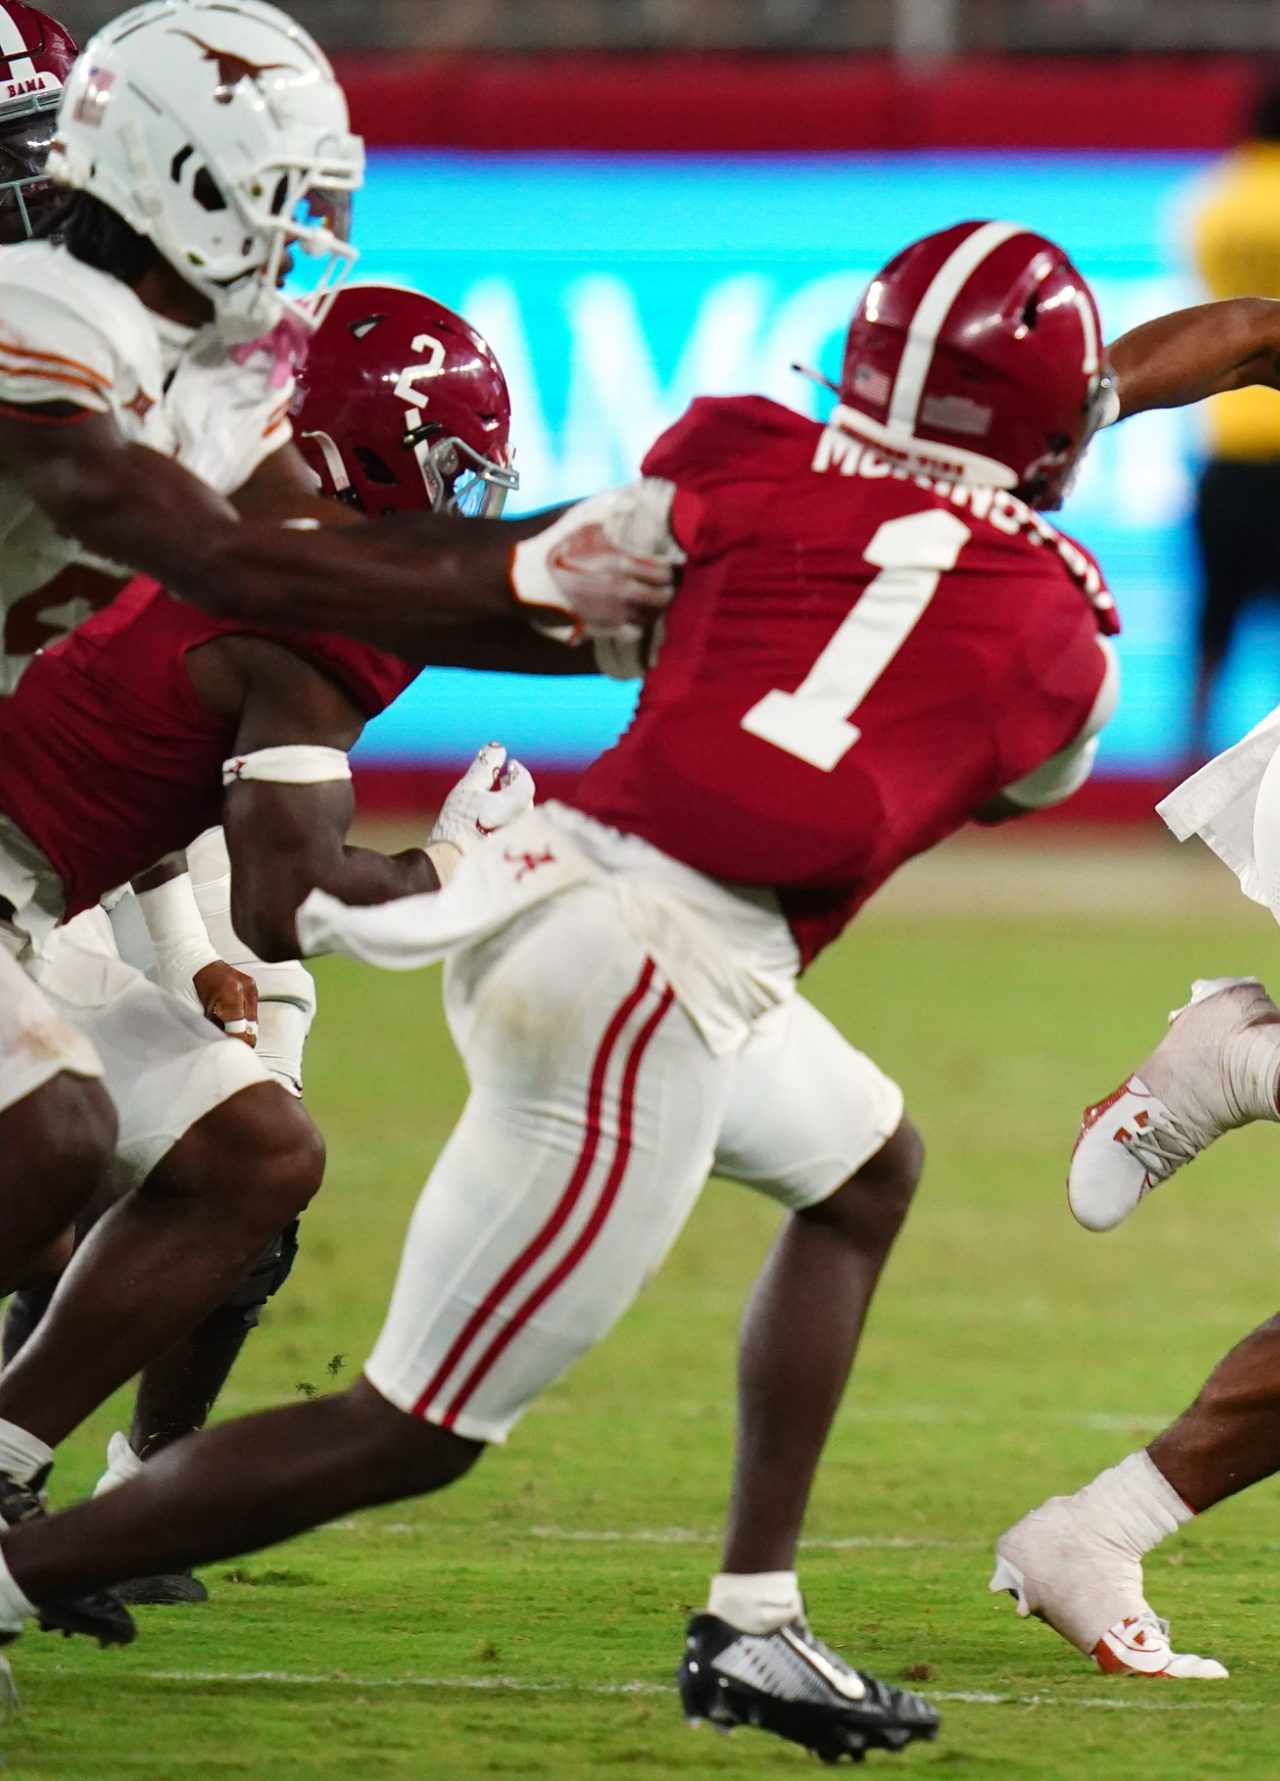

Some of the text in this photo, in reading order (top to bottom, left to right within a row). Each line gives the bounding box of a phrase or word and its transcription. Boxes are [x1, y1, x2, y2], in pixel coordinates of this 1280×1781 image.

[7, 77, 46, 97] BAMA
[393, 333, 446, 409] 2
[740, 508, 972, 774] 1
